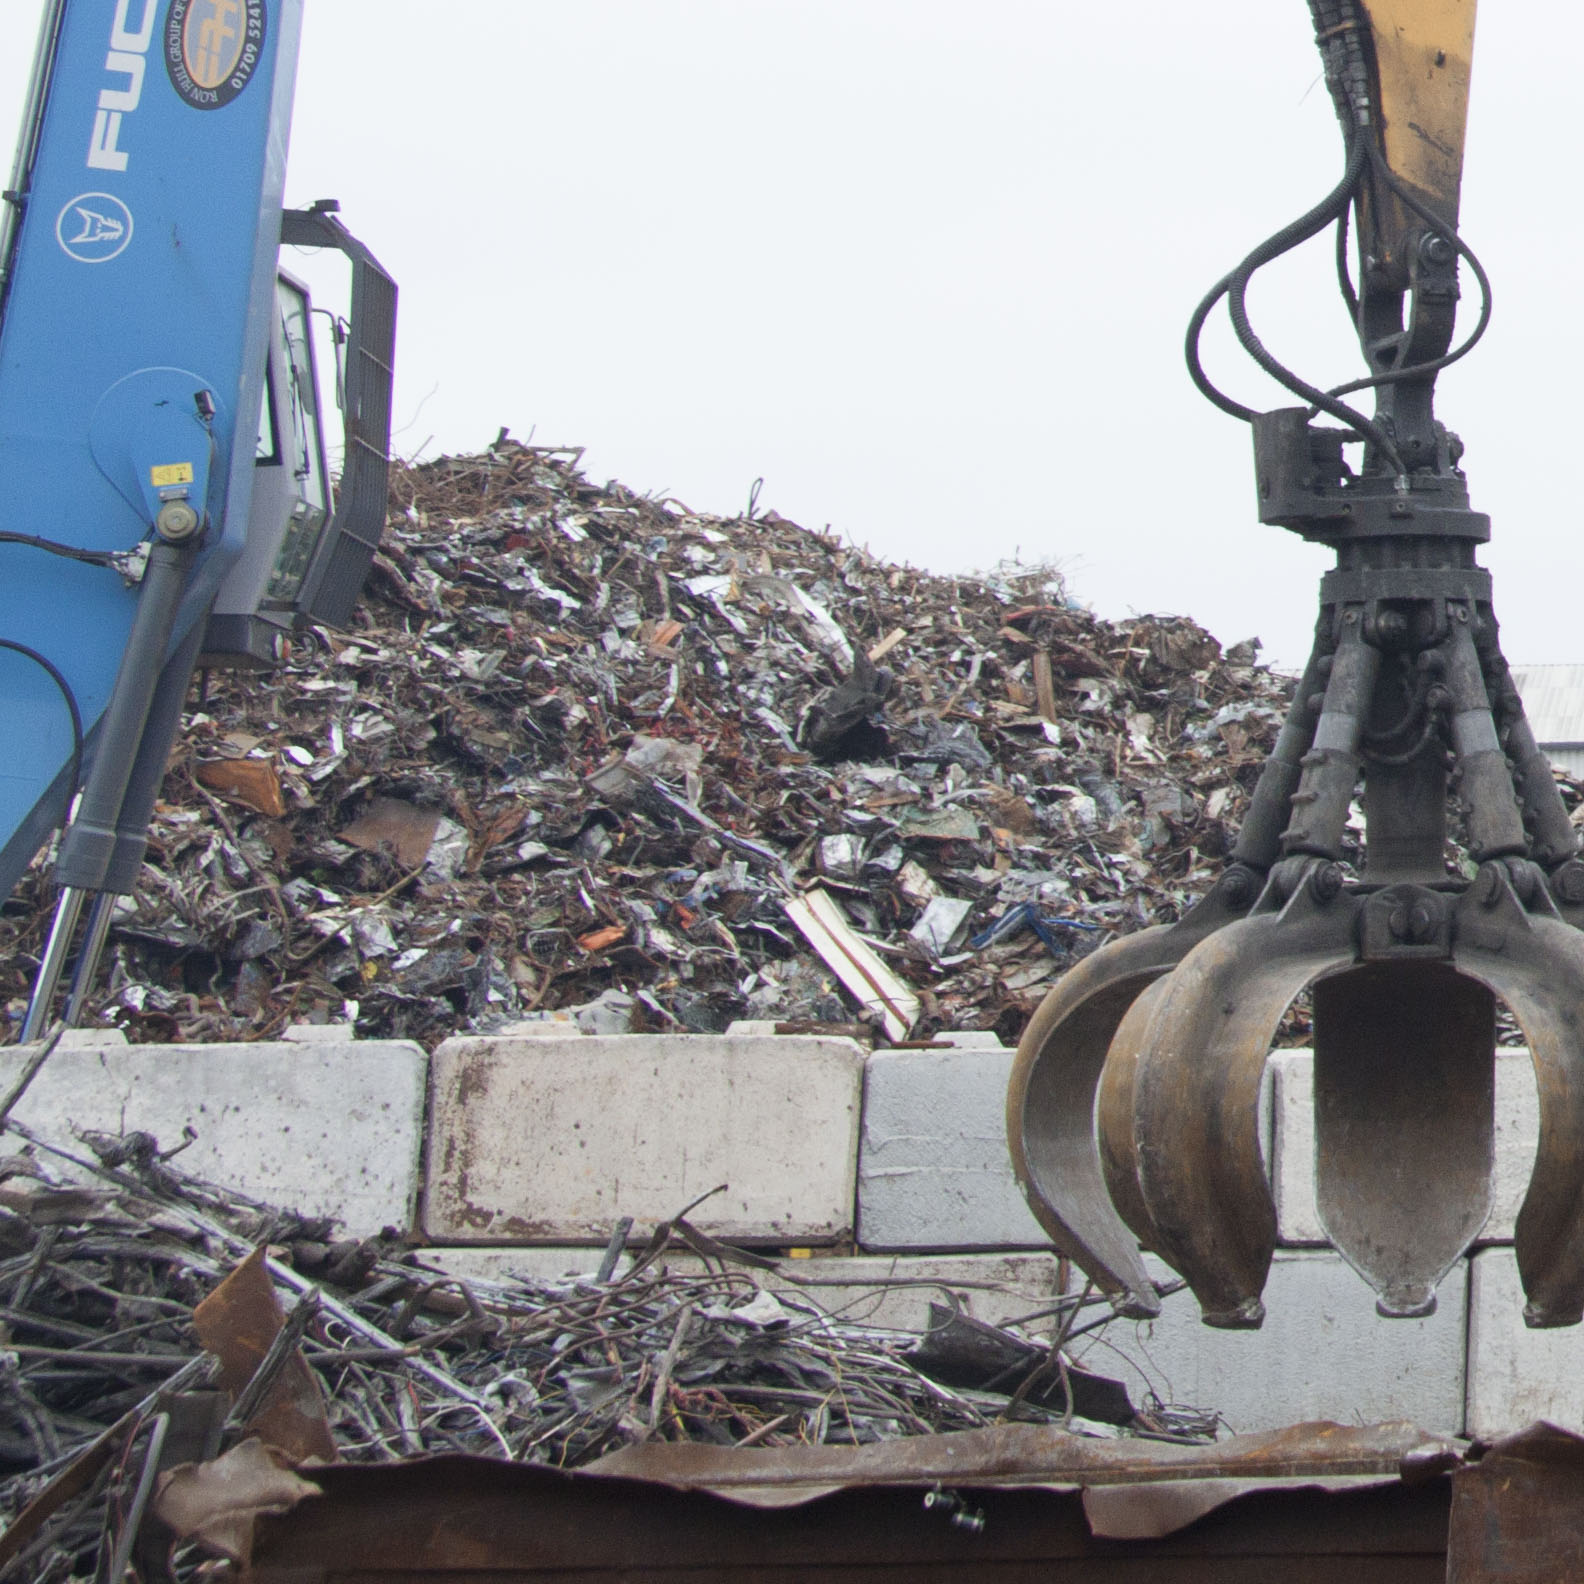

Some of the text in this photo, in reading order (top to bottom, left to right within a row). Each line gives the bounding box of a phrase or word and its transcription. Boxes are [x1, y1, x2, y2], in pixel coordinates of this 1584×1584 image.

[173, 0, 185, 19] OF
[169, 20, 182, 62] GROUP
[174, 62, 194, 92] HULL
[231, 43, 258, 88] 01709
[190, 87, 218, 103] RON
